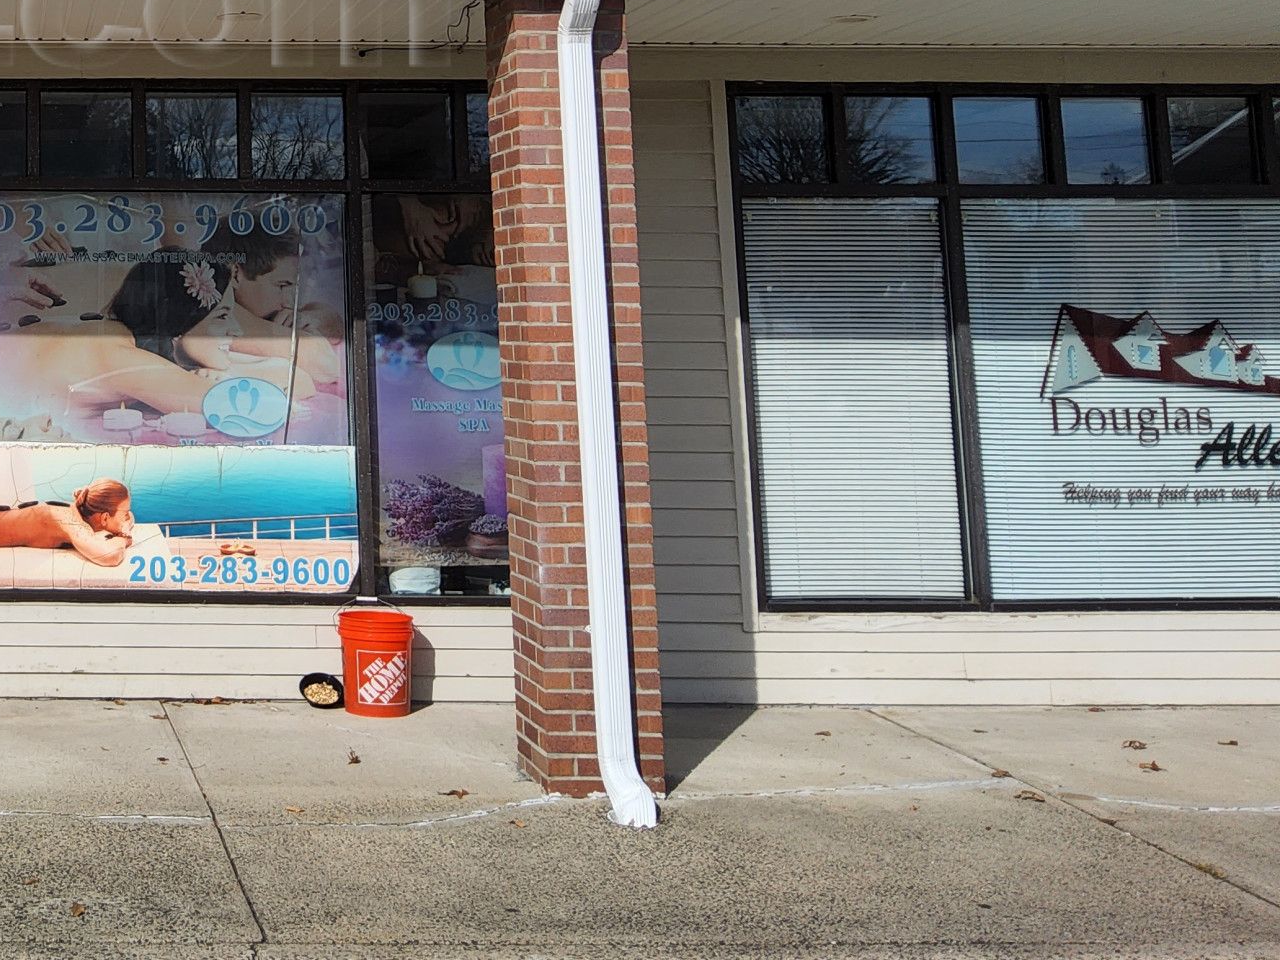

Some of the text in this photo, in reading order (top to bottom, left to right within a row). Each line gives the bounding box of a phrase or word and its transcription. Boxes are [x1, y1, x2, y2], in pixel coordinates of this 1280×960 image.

[412, 397, 471, 414] Massage
[457, 417, 490, 432] SPA
[1048, 396, 1212, 444] Douglas
[1062, 482, 1121, 506] Helping
[1128, 487, 1153, 504] you
[1158, 484, 1189, 505] find
[1193, 486, 1226, 505] your
[1231, 486, 1261, 505] way
[128, 554, 352, 587] 203-283-9600
[358, 651, 407, 704] HOME
[362, 657, 387, 679] THE
[378, 672, 408, 705] DEPOT
